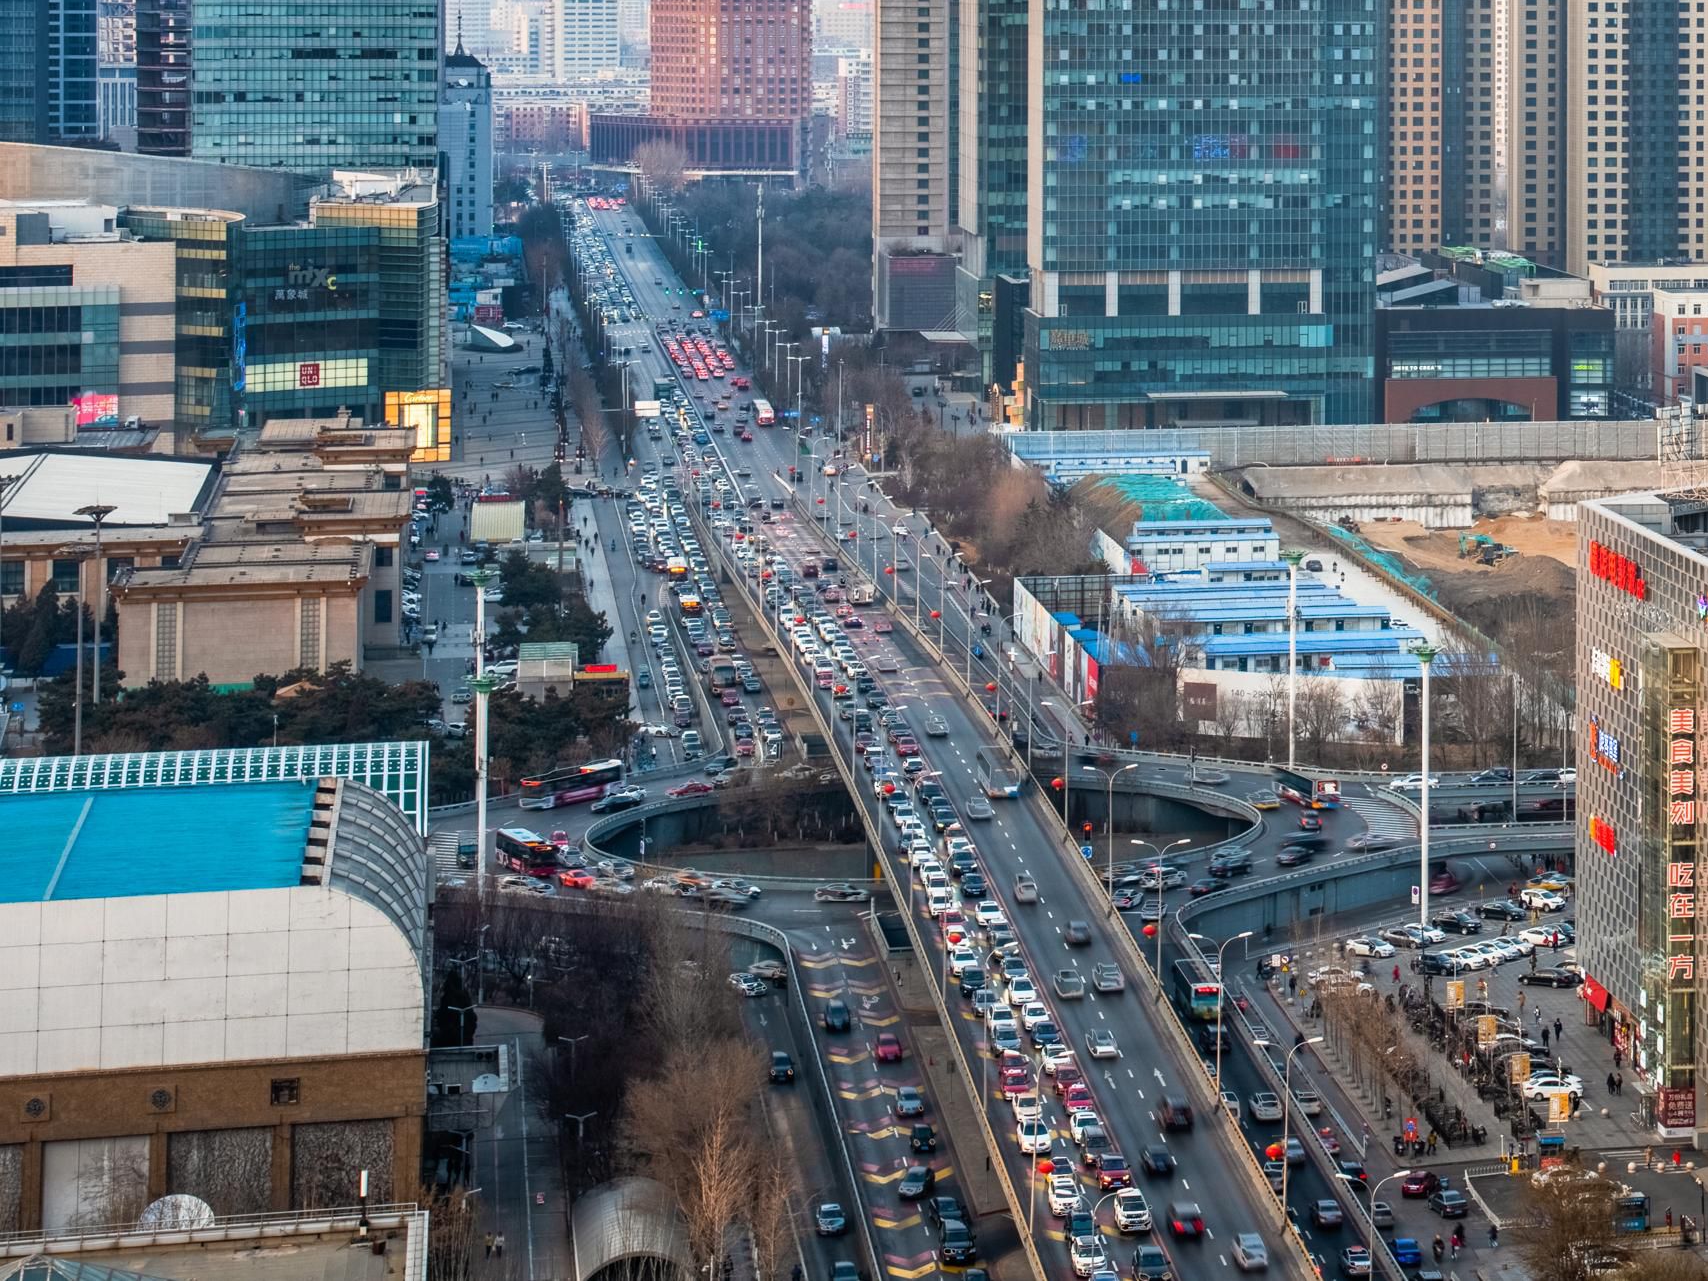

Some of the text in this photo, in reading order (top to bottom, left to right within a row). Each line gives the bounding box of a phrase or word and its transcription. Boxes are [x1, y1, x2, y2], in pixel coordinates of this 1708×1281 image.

[1669, 708, 1695, 825] 美食美刻
[1669, 862, 1695, 980] 吃在一方
